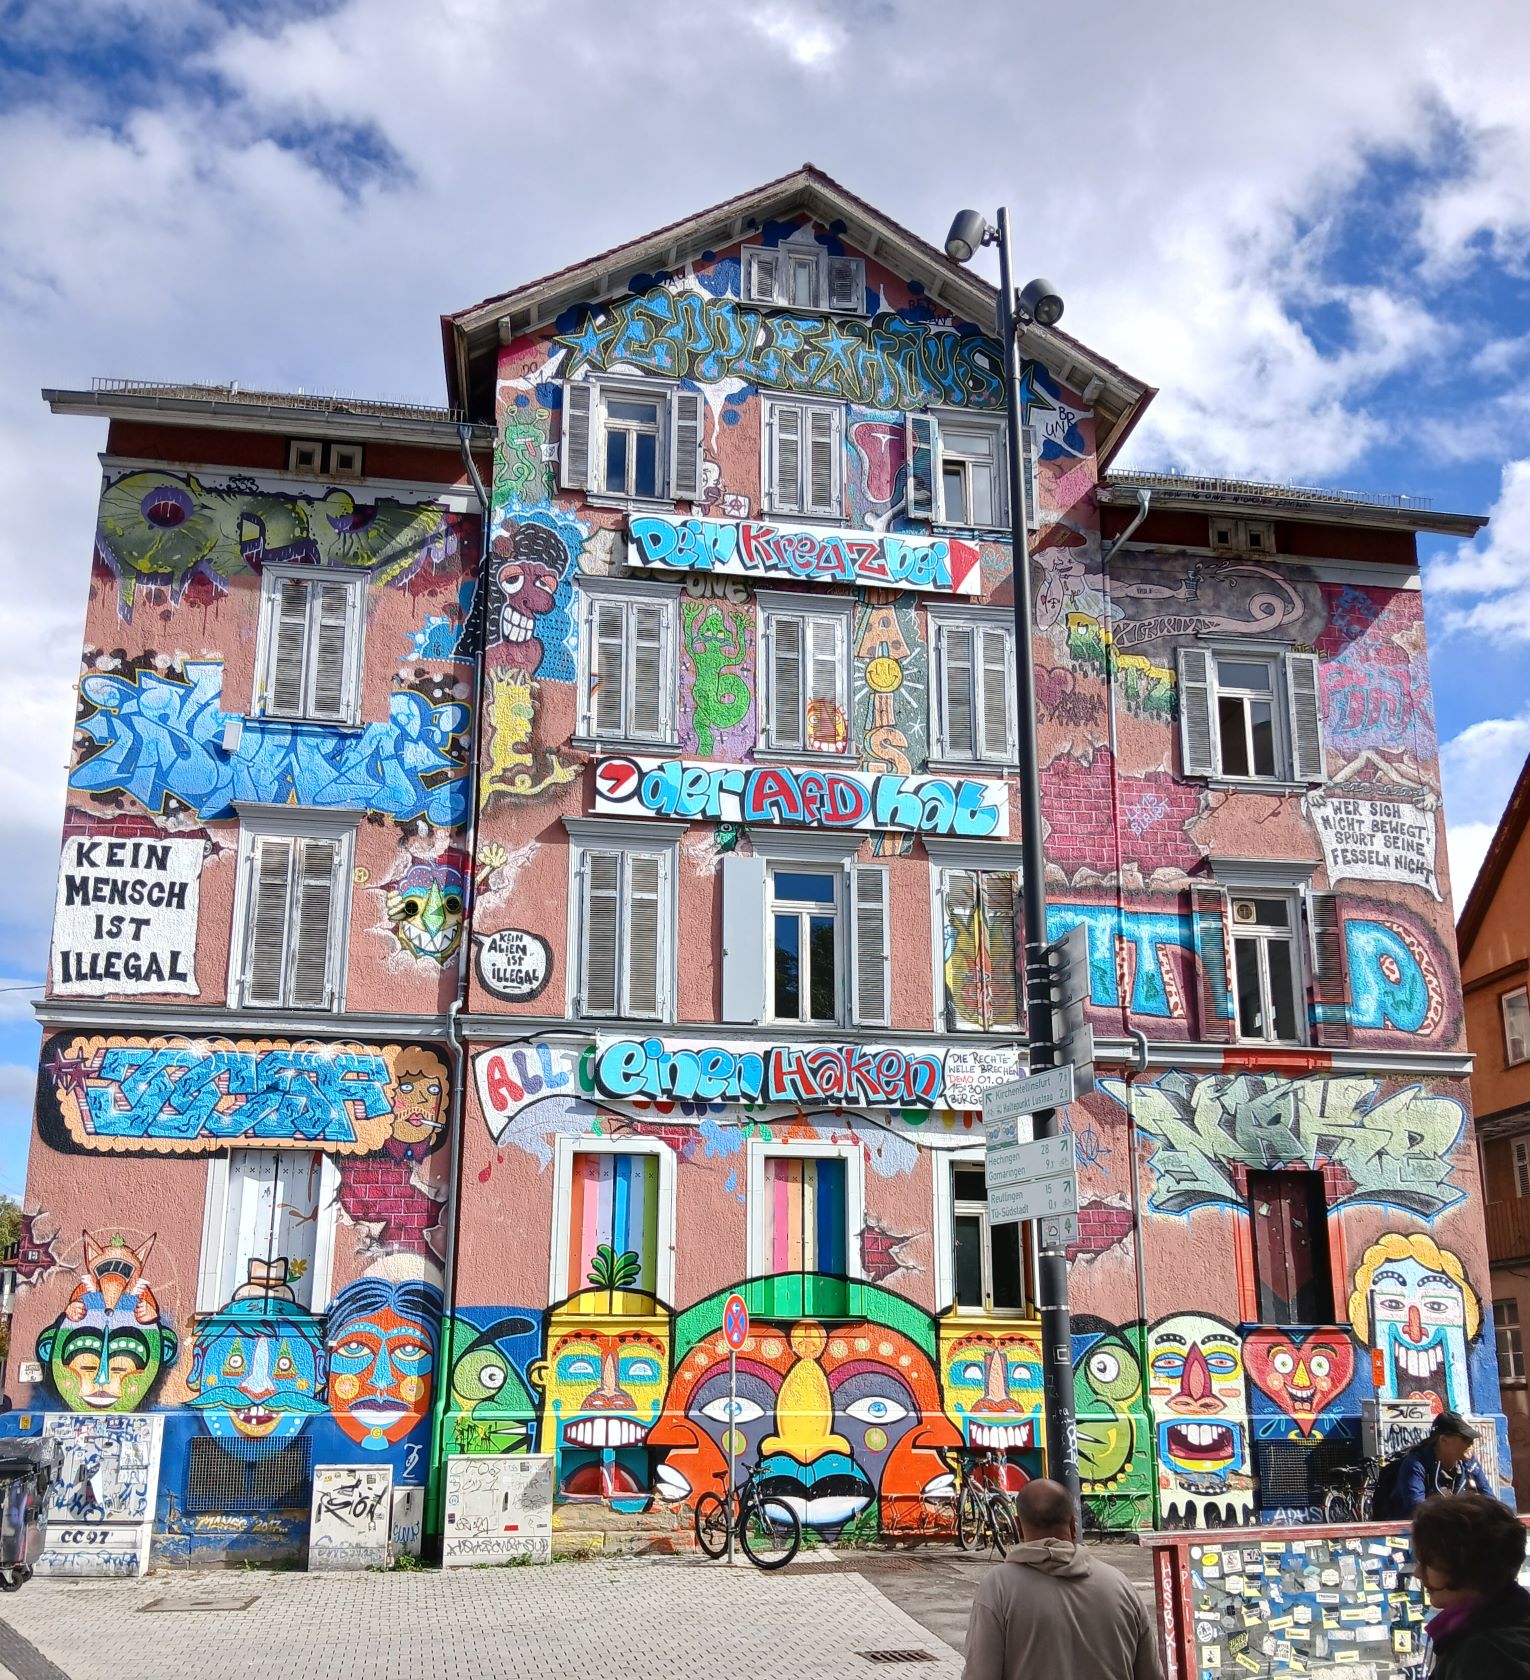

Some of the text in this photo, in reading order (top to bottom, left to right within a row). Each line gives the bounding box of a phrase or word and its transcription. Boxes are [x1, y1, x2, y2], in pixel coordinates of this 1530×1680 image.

[630, 517, 738, 567] Dein
[737, 520, 890, 582] Kreuz
[880, 537, 953, 590] bei
[637, 761, 1002, 837] der AfD hat
[1330, 800, 1402, 819] WER SICH
[1321, 815, 1365, 832] NICHT
[76, 840, 172, 872] KEIN
[1383, 834, 1426, 857] SEINE
[1330, 847, 1433, 884] FESSELN NICHT
[65, 874, 189, 910] MENSCH
[93, 913, 152, 942] IST
[60, 949, 189, 985] ILLEGAL
[949, 1051, 1011, 1065] DIE RECHTE
[486, 1042, 569, 1112] ALL
[596, 1038, 764, 1103] einen
[763, 1045, 944, 1109] Haken
[947, 1074, 974, 1084] DEMO
[948, 1064, 1020, 1077] WELLE BRECHEN
[988, 1144, 1049, 1167] Hechingen 28
[988, 1167, 1026, 1181] Gomaringen
[991, 1183, 1052, 1204] Reutlingen 15
[991, 1204, 1029, 1219] Tü-Südstadt
